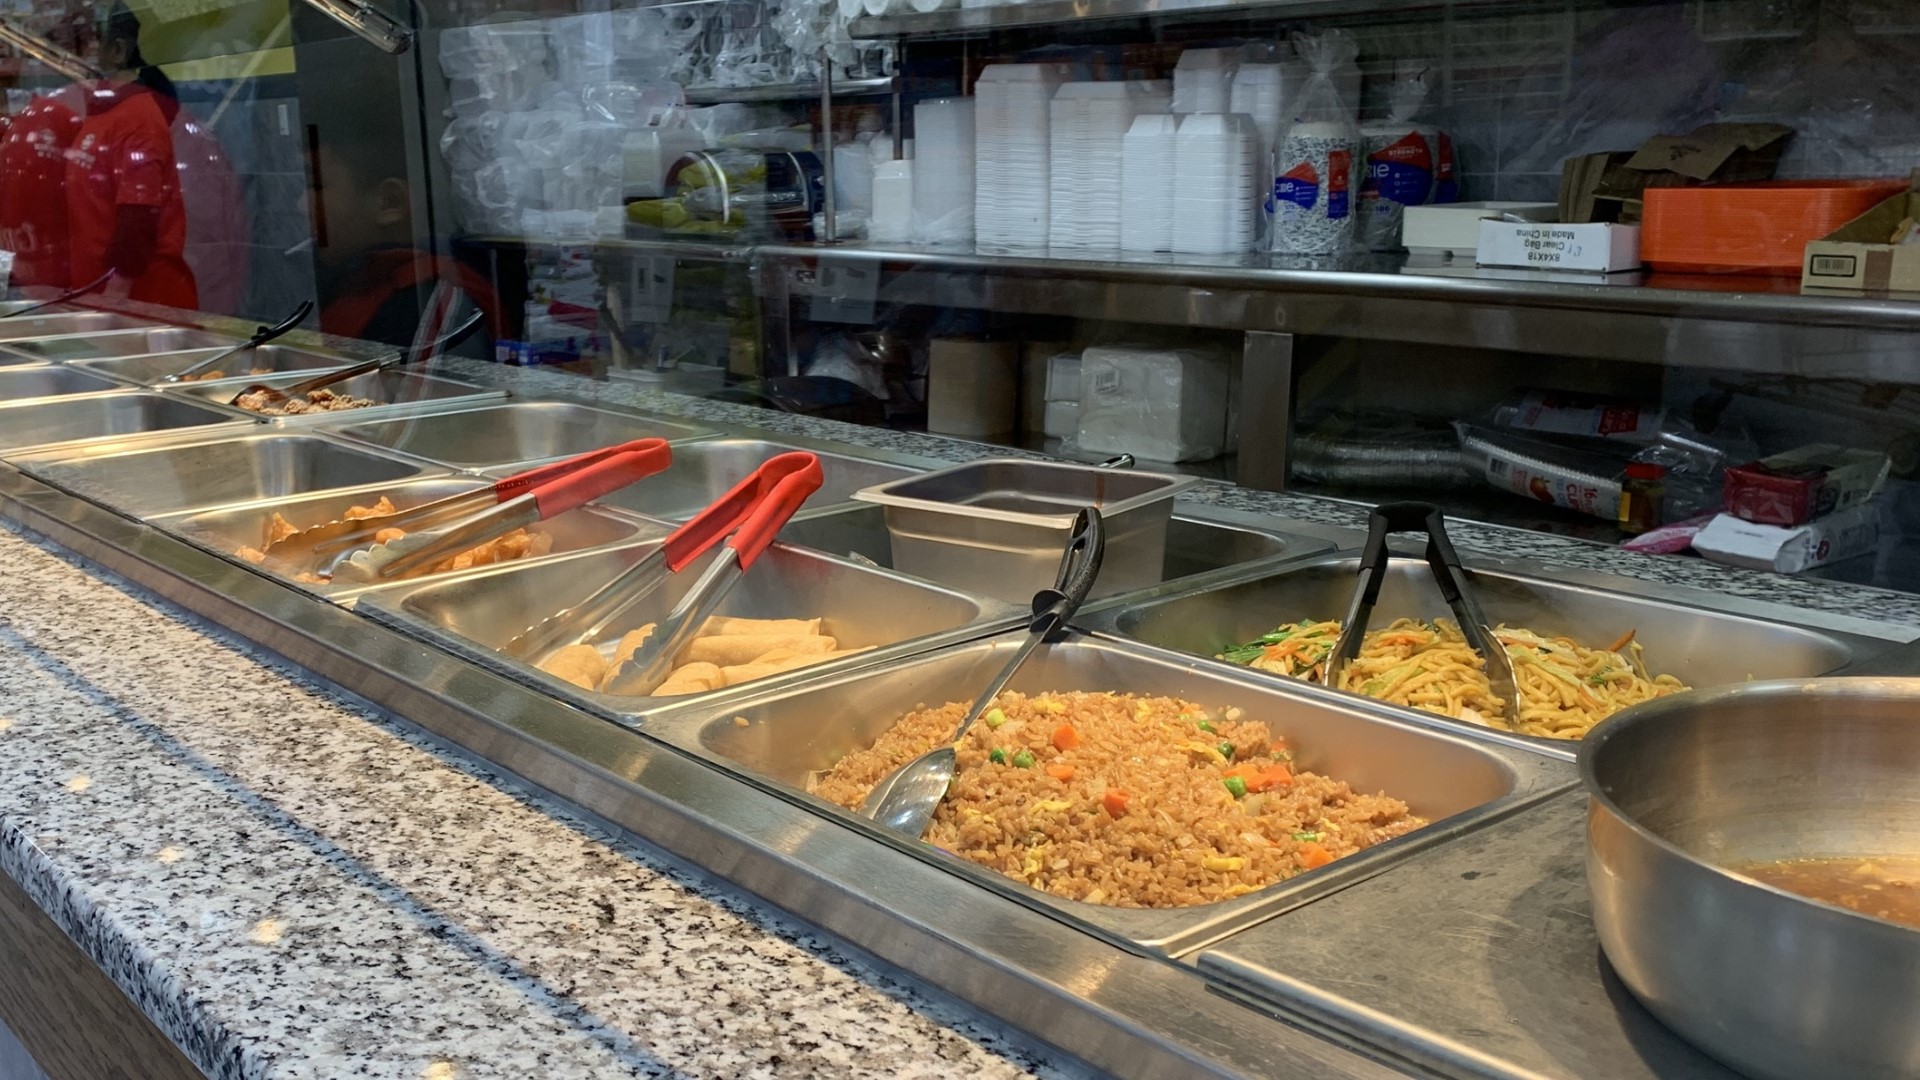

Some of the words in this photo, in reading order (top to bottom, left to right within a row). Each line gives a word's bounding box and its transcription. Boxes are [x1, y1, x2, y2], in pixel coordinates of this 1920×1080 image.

[1516, 229, 1541, 239] China
[1551, 231, 1575, 240] Made
[1524, 239, 1541, 250] Bag
[1542, 241, 1565, 251] Clear
[1528, 252, 1561, 262] 8X4X18
